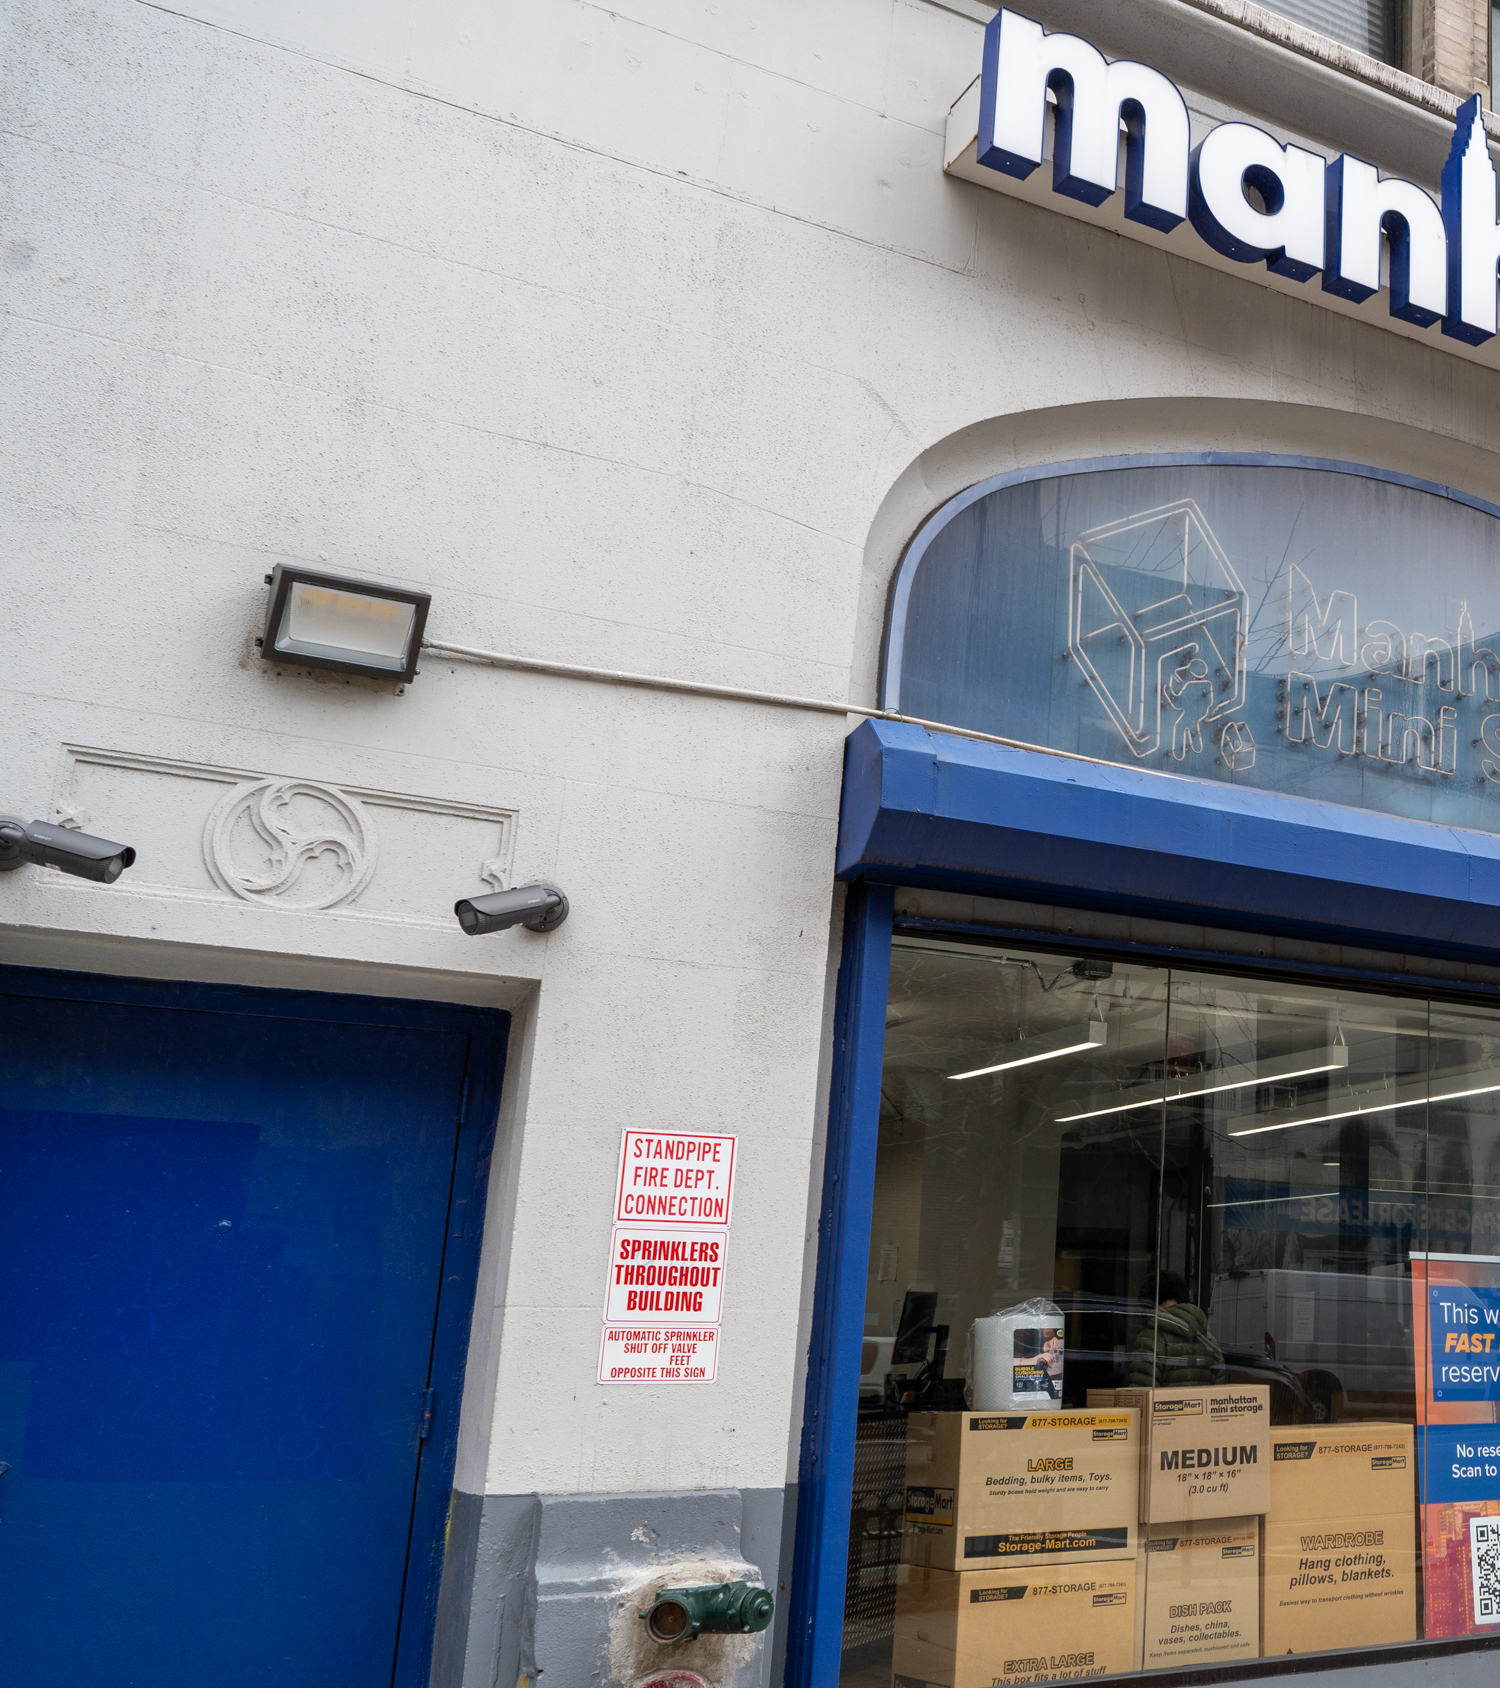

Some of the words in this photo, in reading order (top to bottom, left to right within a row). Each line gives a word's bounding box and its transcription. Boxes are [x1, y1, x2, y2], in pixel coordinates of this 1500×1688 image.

[1286, 671, 1457, 775] Mini
[633, 1138, 722, 1163] STANDPIPE
[633, 1166, 669, 1187] FIRE
[673, 1168, 719, 1190] DEPT.
[624, 1194, 723, 1218] CONNECTION
[619, 1239, 719, 1262] SPRINKLERS
[615, 1264, 720, 1287] THROUGHOUT
[626, 1290, 703, 1312] BUILDING
[1439, 1302, 1479, 1325] This
[608, 1330, 661, 1341] AUTOMATIC
[663, 1331, 715, 1342] SPRINKLER
[1445, 1333, 1494, 1353] FAST
[624, 1343, 649, 1354] SHUT
[651, 1343, 669, 1354] OFF
[671, 1343, 698, 1354] VALVE
[669, 1355, 691, 1366] FEET
[610, 1367, 657, 1378] OPPOSITE
[660, 1367, 681, 1378] THIS
[684, 1367, 706, 1378] SIGN
[1210, 1393, 1257, 1406] manhattan
[1210, 1405, 1228, 1414] mini
[1229, 1403, 1263, 1414] storage
[1032, 1417, 1096, 1427] 877-STORAGE
[1318, 1444, 1373, 1454] 877-STORAGE
[1456, 1443, 1474, 1458] No
[1027, 1457, 1073, 1472] LARGE
[1160, 1445, 1257, 1471] MEDIUM
[1452, 1463, 1482, 1478] Scan
[1485, 1464, 1497, 1477] to
[985, 1476, 1028, 1487] Bedding,
[1030, 1474, 1055, 1485] bulky
[1058, 1473, 1085, 1483] items,
[1089, 1472, 1113, 1482] Toys.
[989, 1489, 1007, 1497] Sturdy
[1188, 1485, 1204, 1496] (3.0
[1207, 1485, 1217, 1493] cu
[1219, 1483, 1229, 1493] ft)
[1020, 1533, 1043, 1541] Friendly
[1180, 1536, 1232, 1547] 877-STORAGE
[1301, 1531, 1384, 1551] WARDROBE
[998, 1538, 1096, 1552] Storage-Mart.com
[1299, 1558, 1331, 1571] Hang
[1335, 1553, 1386, 1567] clothing,
[1289, 1573, 1337, 1590] pillows,
[1341, 1567, 1394, 1582] blankets.
[1032, 1582, 1096, 1596] 877-STORAGE
[1318, 1595, 1342, 1603] transport
[1343, 1593, 1364, 1601] clothing
[1169, 1604, 1197, 1618] DISH
[1199, 1600, 1232, 1616] PACK
[1170, 1623, 1202, 1634] Dishes,
[1205, 1620, 1230, 1630] china,
[1158, 1636, 1186, 1645] vases,
[1188, 1630, 1242, 1642] collectables.
[1004, 1657, 1048, 1675] EXTRA
[1050, 1652, 1094, 1669] LARGE
[991, 1677, 1012, 1687] This
[1014, 1674, 1032, 1684] box
[1034, 1672, 1049, 1682] fits
[1059, 1670, 1071, 1679] lot
[1073, 1668, 1084, 1678] of
[1085, 1666, 1107, 1677] stuff
